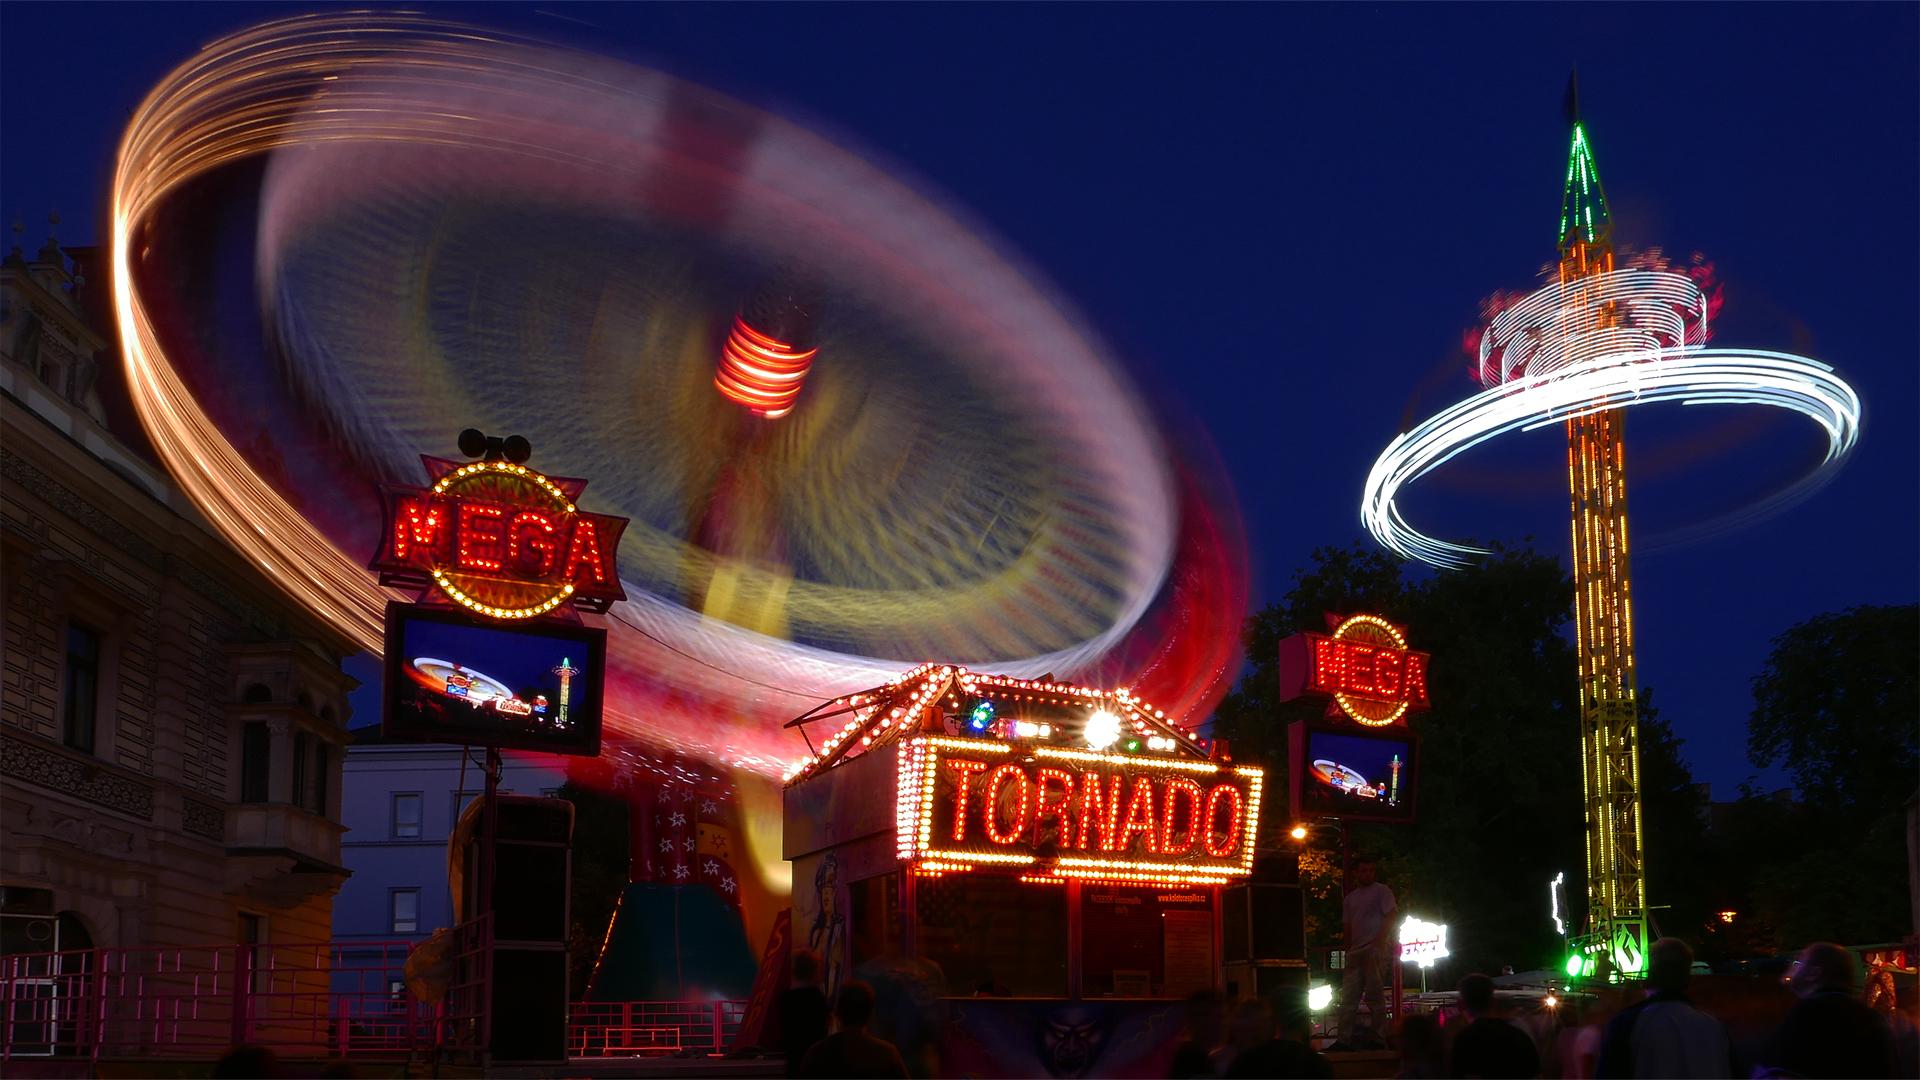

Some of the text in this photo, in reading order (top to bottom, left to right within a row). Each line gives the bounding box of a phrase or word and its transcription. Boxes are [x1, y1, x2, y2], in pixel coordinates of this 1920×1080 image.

[394, 500, 605, 583] MEGA
[1317, 640, 1425, 699] MEGA
[945, 758, 1243, 857] TORNADO
